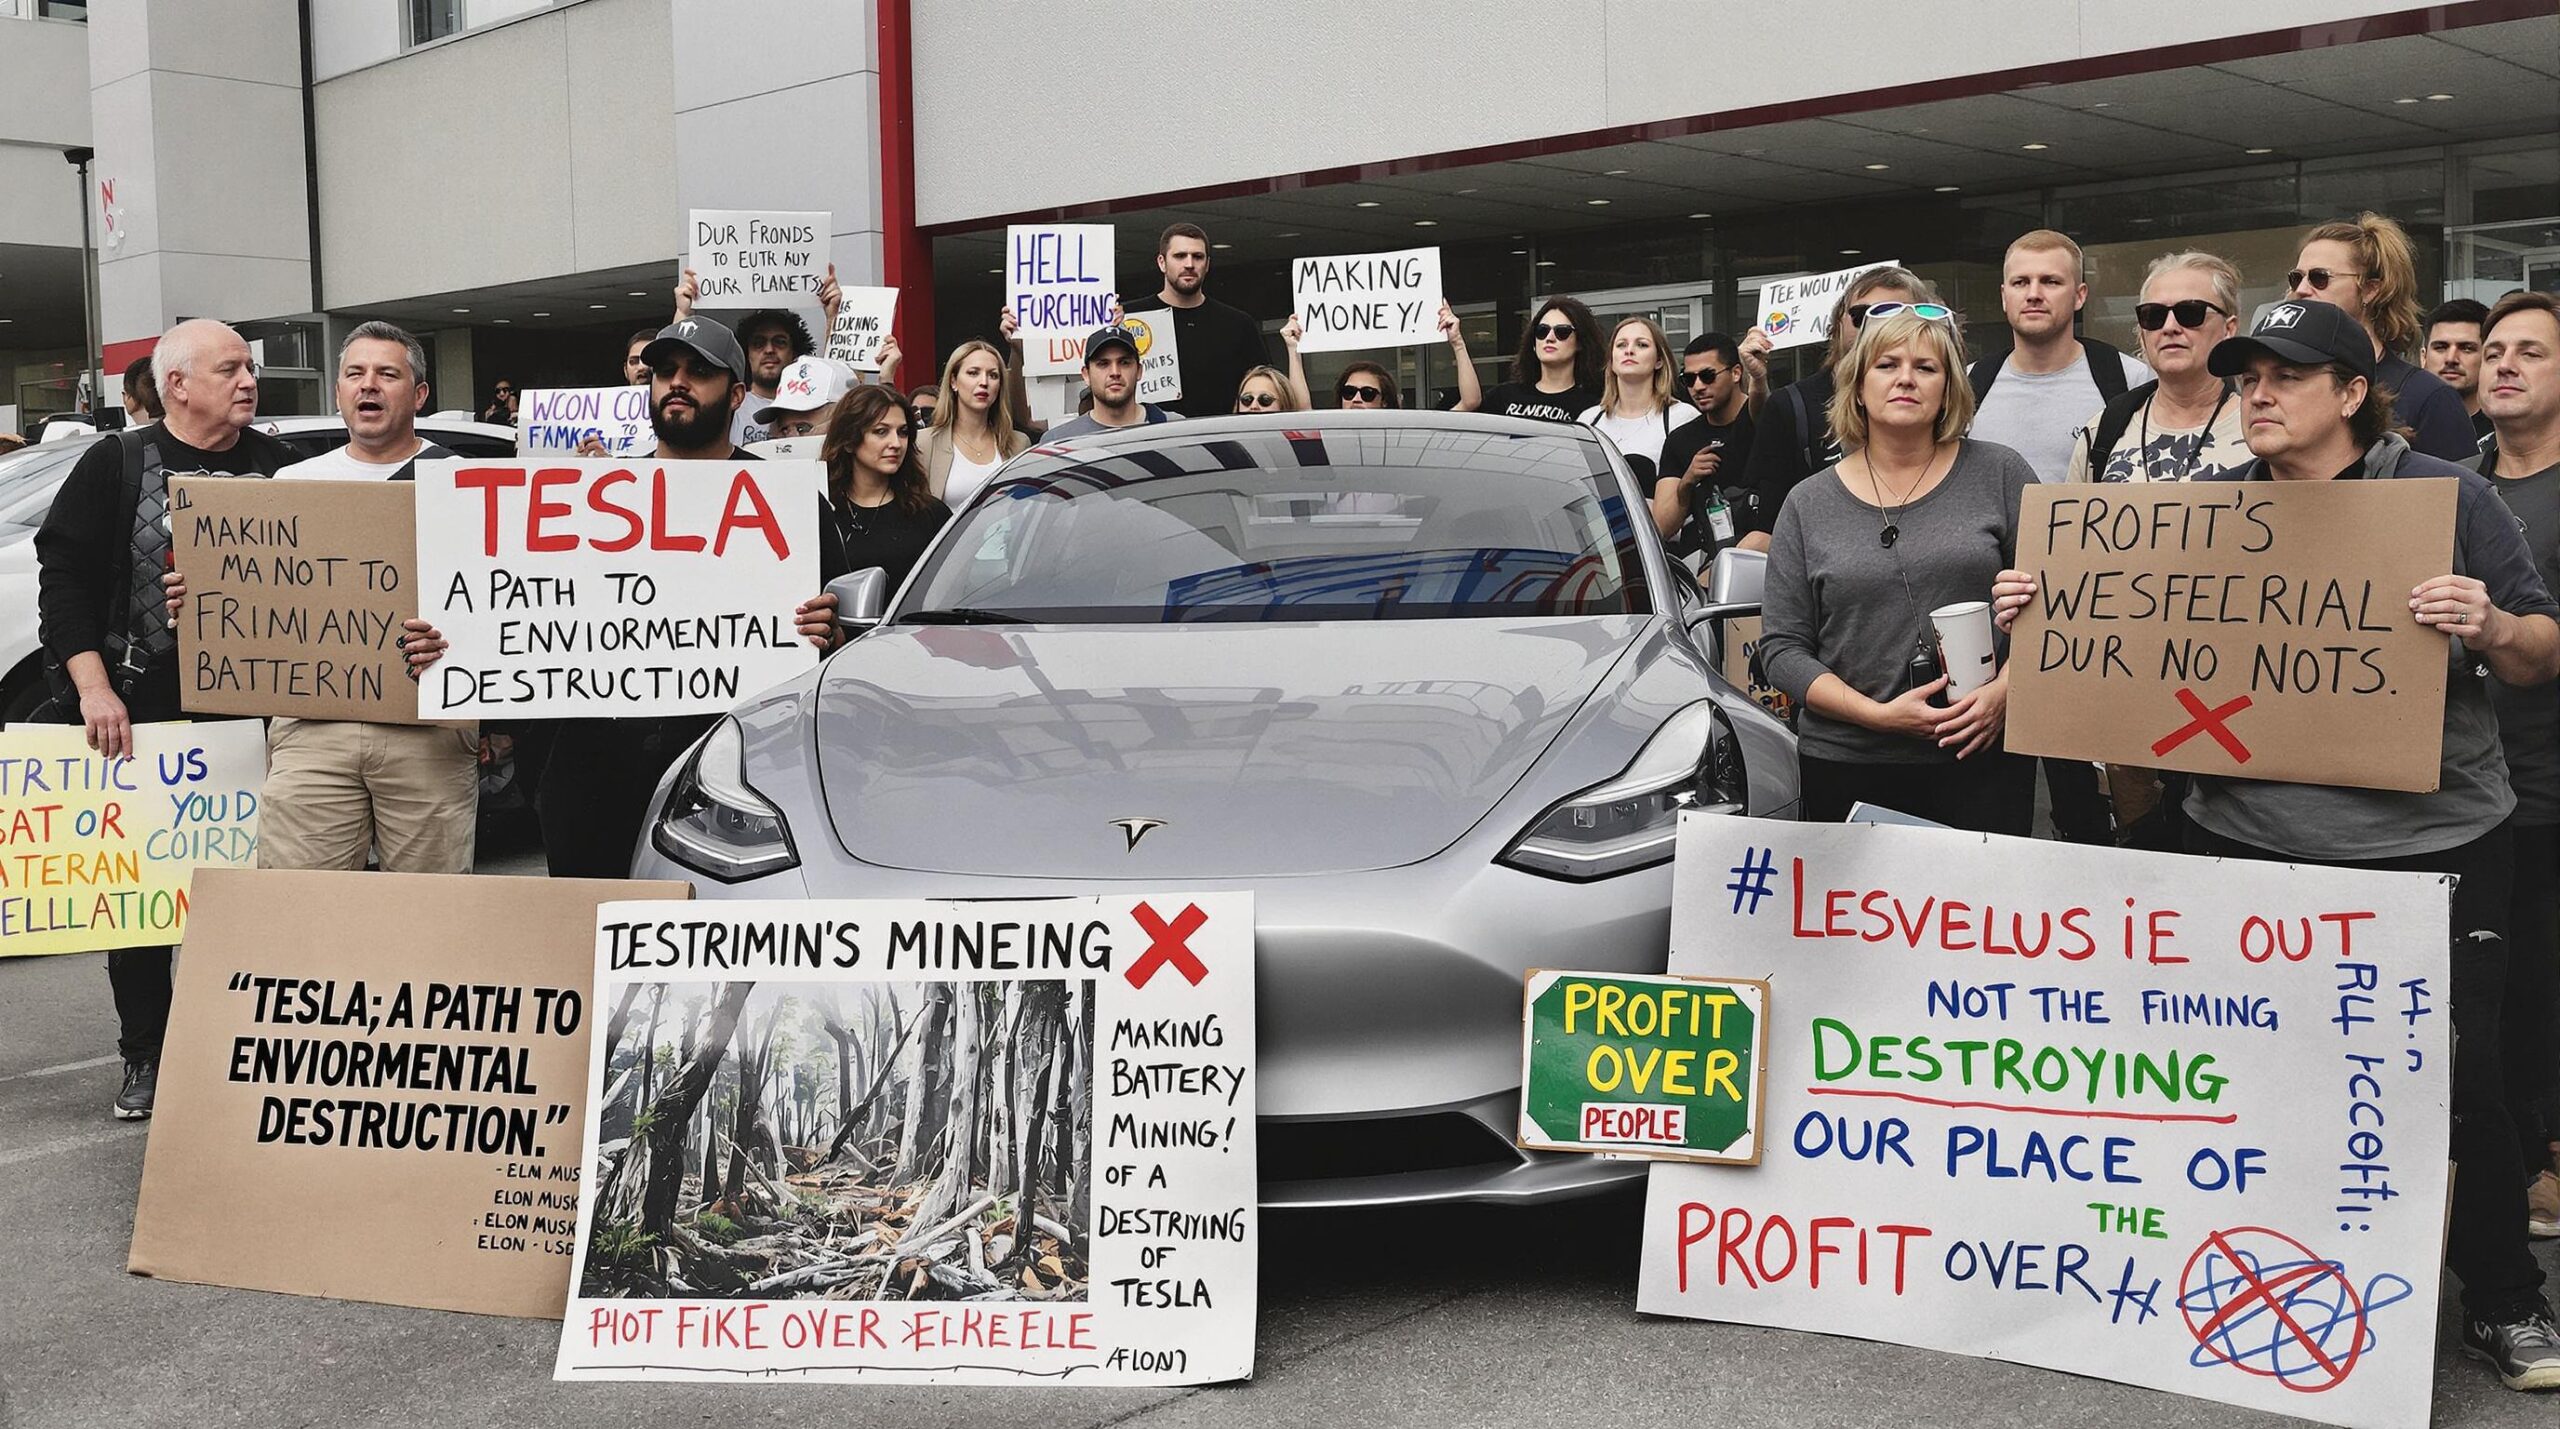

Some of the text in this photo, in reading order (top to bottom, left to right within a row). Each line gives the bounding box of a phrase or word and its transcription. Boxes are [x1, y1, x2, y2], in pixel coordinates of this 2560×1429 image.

[712, 252, 728, 266] TO
[1017, 234, 1099, 285] HELL
[1298, 258, 1422, 293] MAKING
[1306, 301, 1423, 333] MONEY!
[455, 468, 790, 561] TESLA
[2047, 490, 2274, 555] FROFIT'S
[360, 560, 399, 591] TO
[444, 570, 656, 611] A PATH TO
[500, 613, 798, 654] ENVIORMENTAL
[197, 651, 383, 700] BATTERYN
[2040, 630, 2398, 696] DUR NO NOTS.
[443, 666, 739, 709] DESTRUCTION
[158, 748, 208, 786] US
[75, 802, 126, 840] OR
[603, 921, 1112, 973] TESTRIMIN'S MINEING
[2240, 911, 2376, 964] OUT
[386, 981, 415, 1030] A
[423, 983, 523, 1034] PATH
[533, 987, 582, 1037] TO
[1564, 983, 1738, 1039] PROFIT
[1927, 981, 2015, 1021] NOT
[2030, 987, 2111, 1026] THE
[1111, 1014, 1223, 1051] MAKING
[229, 1037, 537, 1096] ENVIORMENTAL
[1587, 1044, 1742, 1103] OVER
[1811, 1017, 2230, 1105] DESTROYING
[1111, 1058, 1246, 1106] BATTERY
[1109, 1113, 1236, 1153] MINING!
[1585, 1107, 1684, 1141] PEOPLE
[1793, 1110, 2268, 1196] OUR PLACE OF
[1106, 1164, 1167, 1188] OF A
[494, 1189, 579, 1212] ELON MUSK
[2086, 1202, 2169, 1240] THE
[478, 1235, 525, 1252] ELON
[485, 1212, 528, 1230] ELON
[532, 1216, 577, 1237] MUSK
[1142, 1247, 1176, 1268] OF
[1677, 1202, 1933, 1297] PROFIT
[1944, 1240, 2102, 1304] OVER
[1111, 1278, 1212, 1309] TESLA
[782, 1314, 887, 1349] OVER
